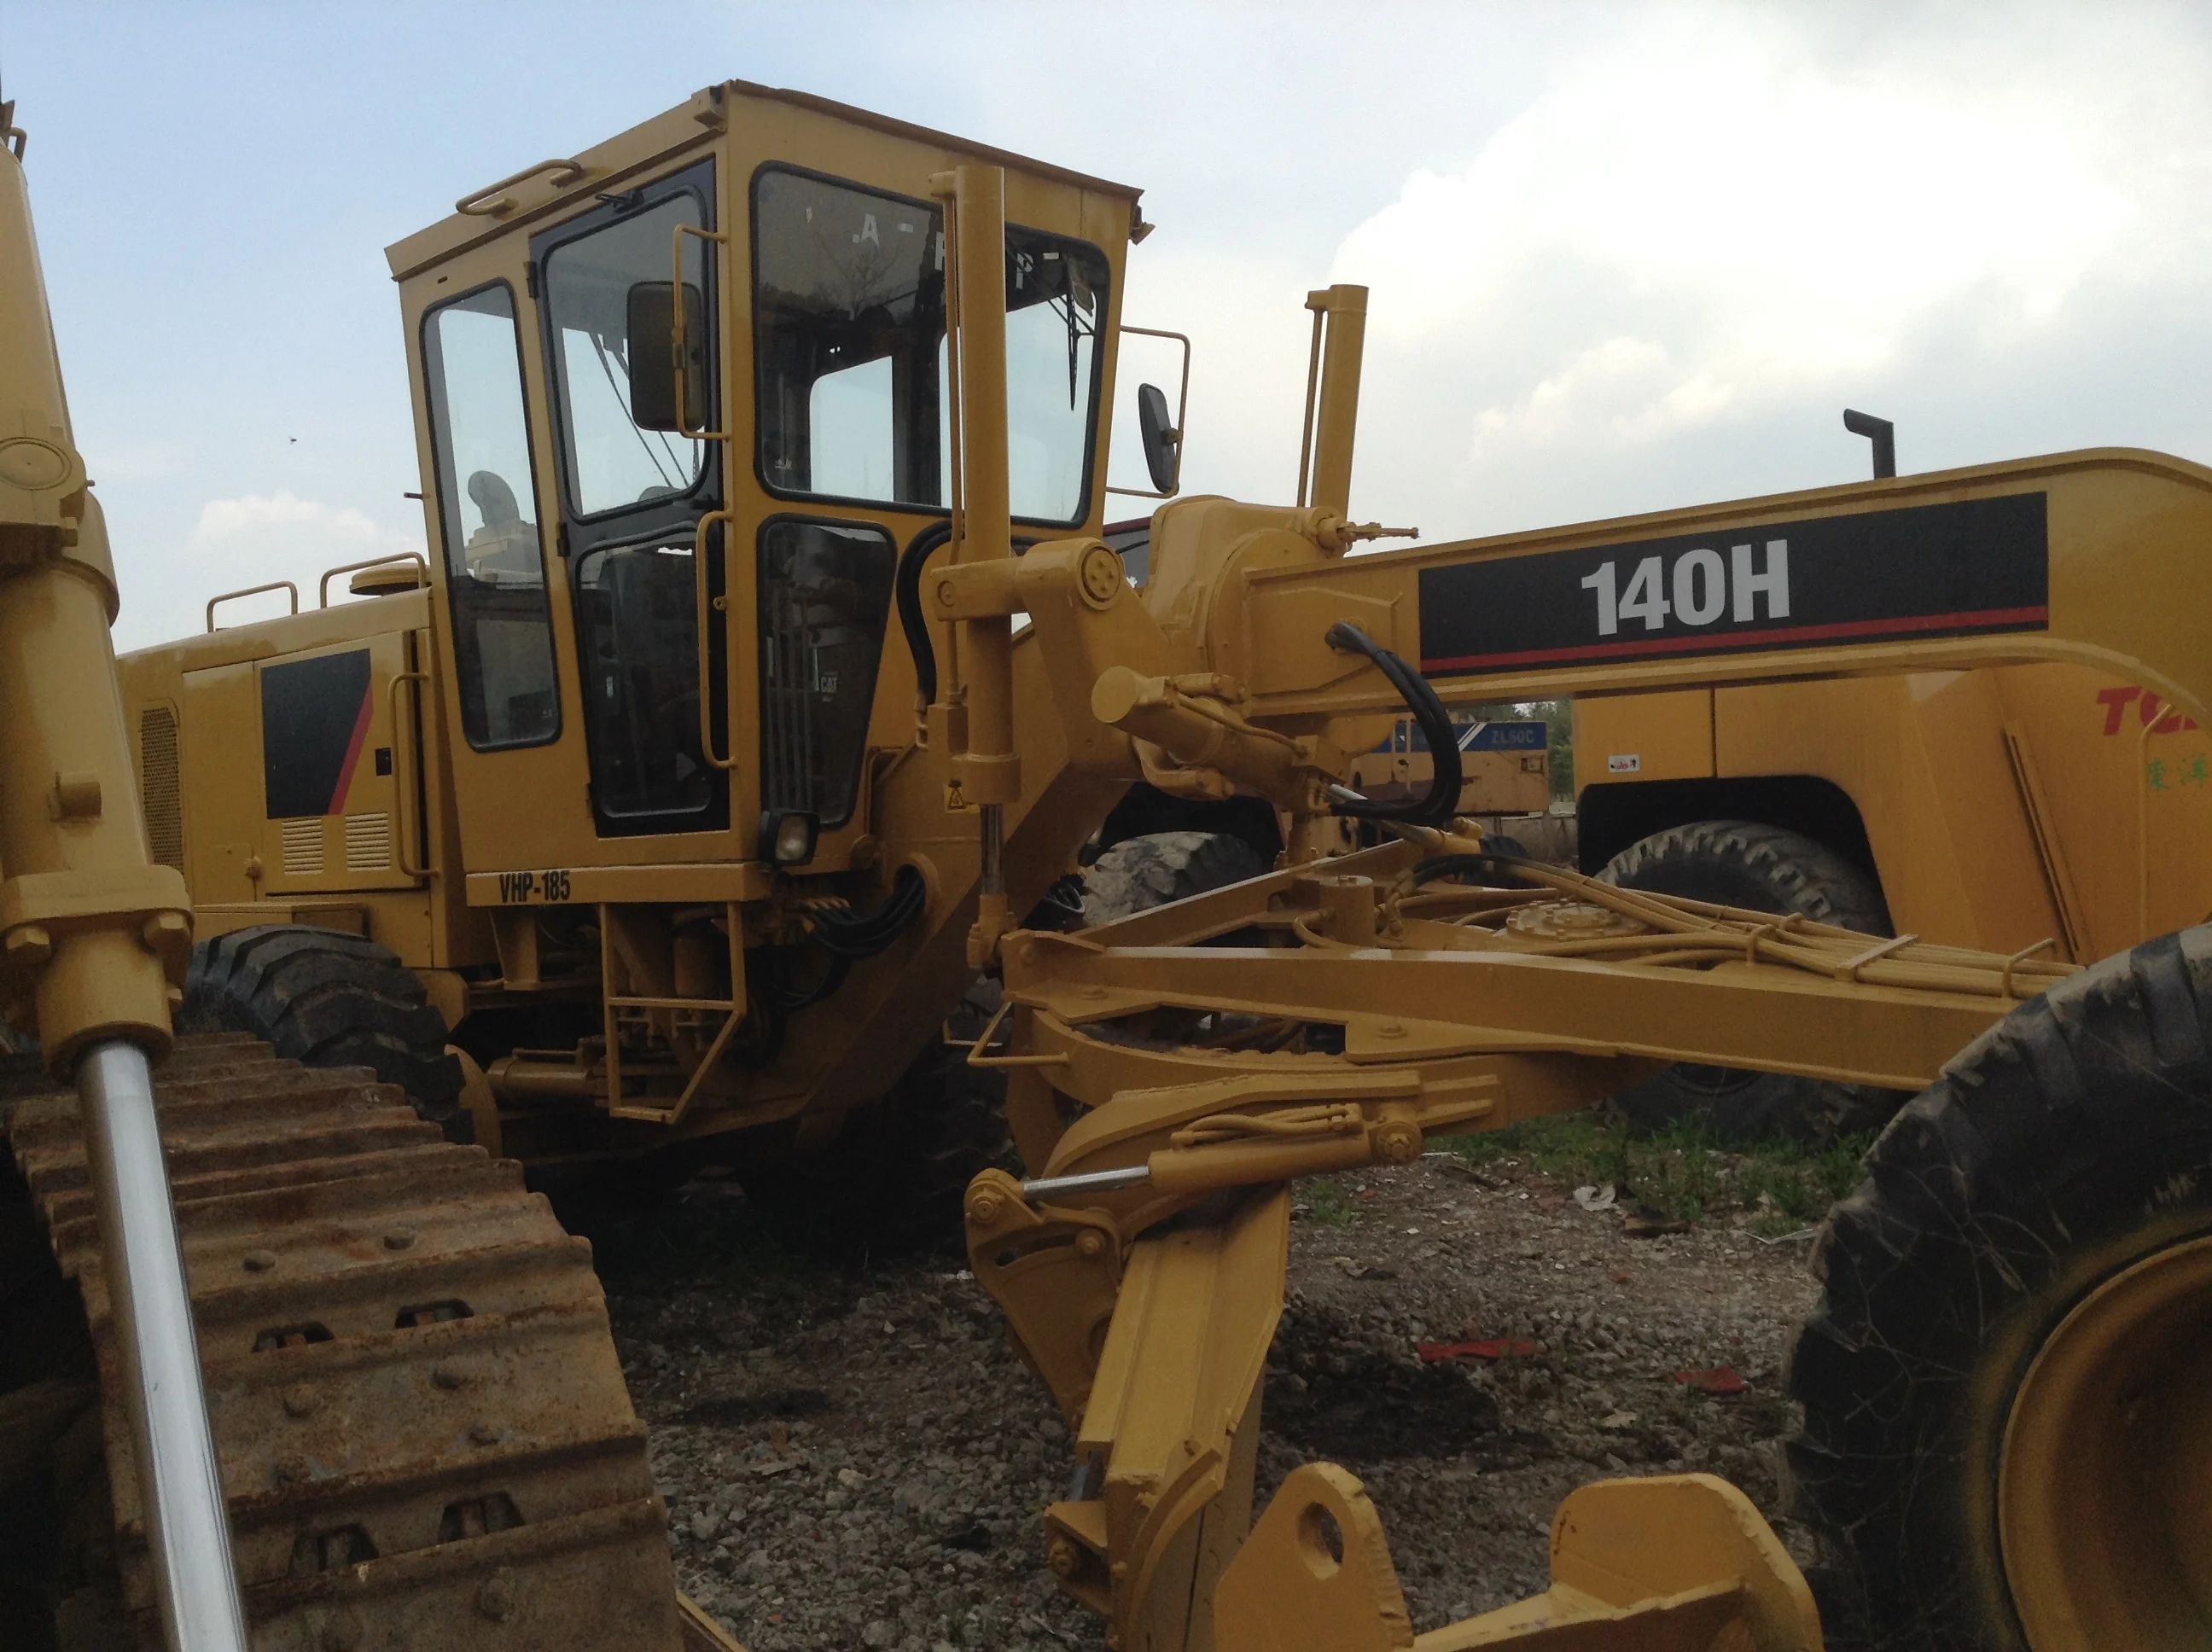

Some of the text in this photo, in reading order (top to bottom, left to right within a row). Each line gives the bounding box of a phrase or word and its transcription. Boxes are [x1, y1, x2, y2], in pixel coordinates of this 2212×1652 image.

[1581, 538, 1790, 636] 140H
[821, 676, 838, 692] CAT
[1491, 730, 1534, 744] ZL50C
[498, 870, 571, 903] VHP-185
